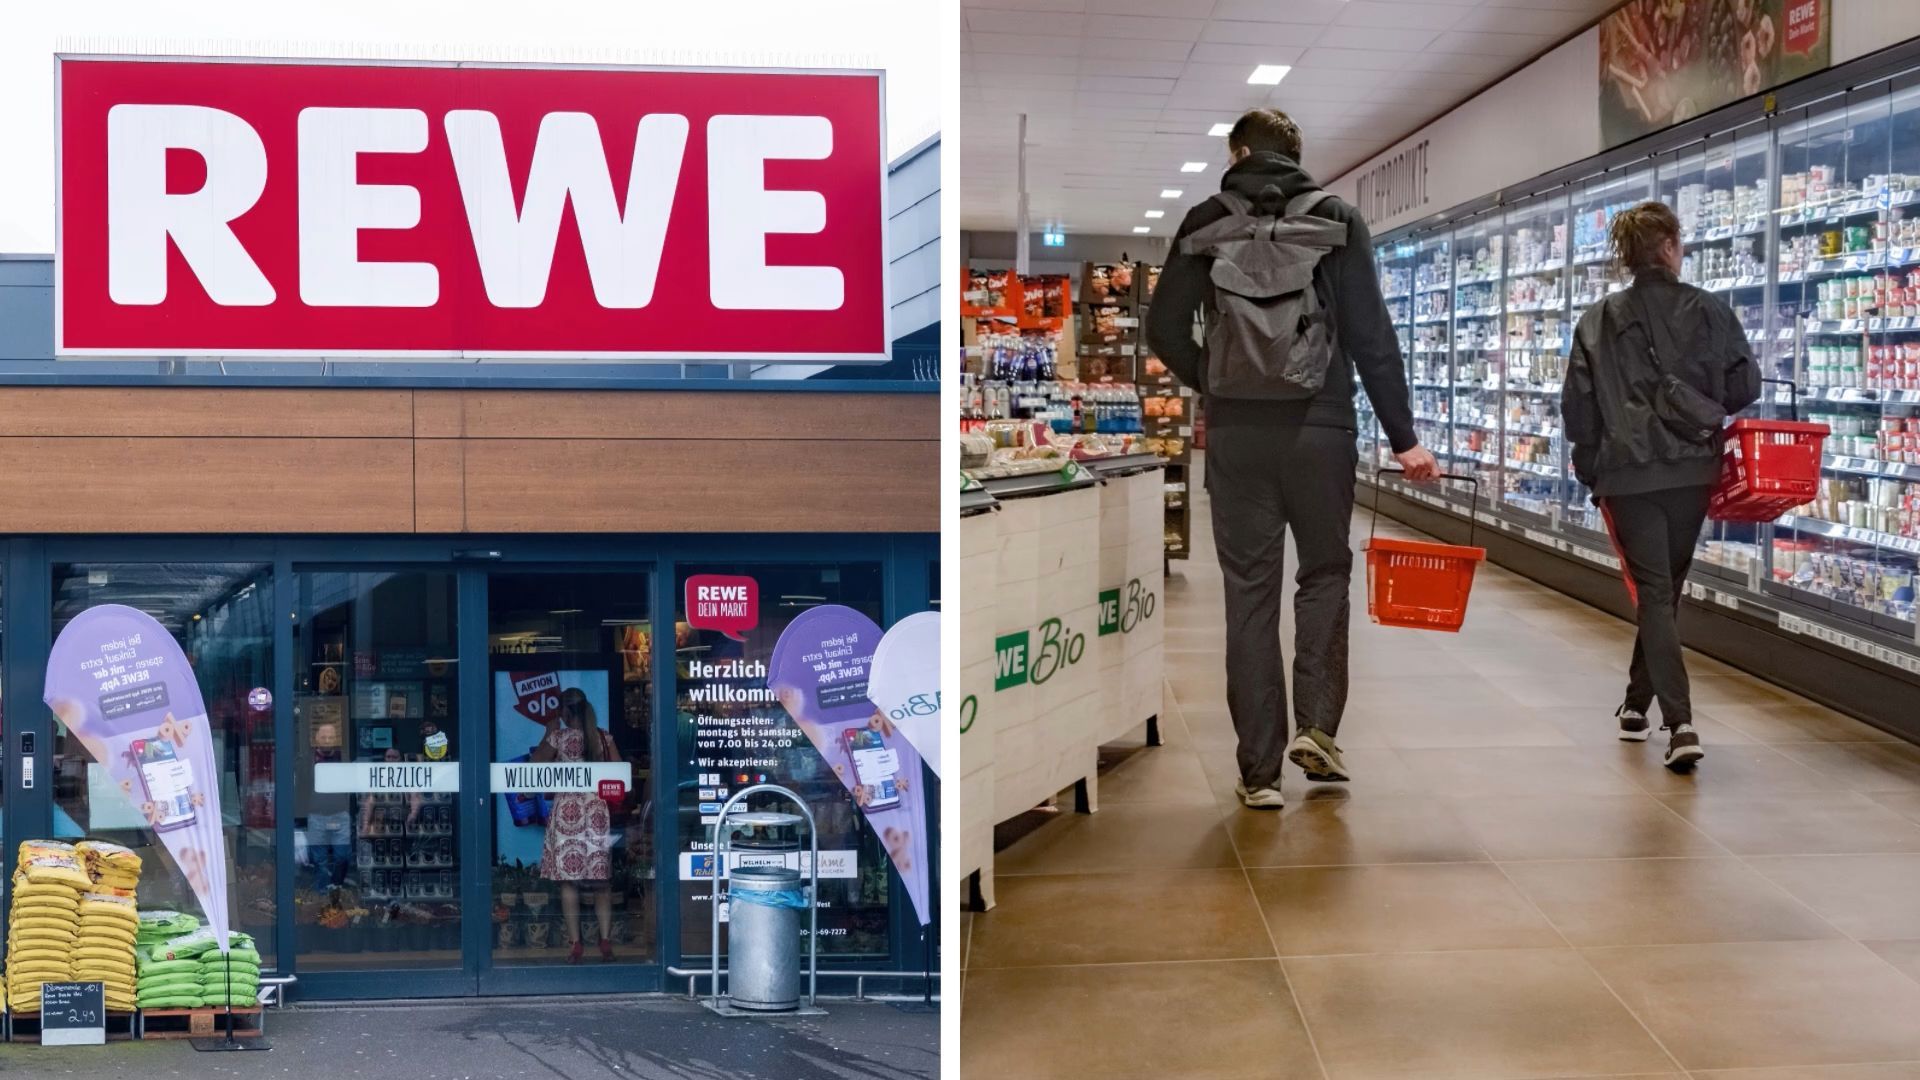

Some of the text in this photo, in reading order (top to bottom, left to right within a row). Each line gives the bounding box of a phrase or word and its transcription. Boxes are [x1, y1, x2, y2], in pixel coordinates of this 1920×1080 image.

[1789, 0, 1815, 26] REWE
[107, 103, 845, 311] REWE
[698, 586, 748, 600] REWE
[698, 602, 748, 616] DEIN MARKT
[1121, 578, 1155, 634] Bio
[1030, 617, 1085, 685] Bio
[689, 660, 766, 678] Herzlich
[520, 674, 553, 693] AKTION
[689, 684, 779, 702] willkomm
[698, 714, 774, 728] Öffnungszeiten:
[698, 728, 802, 738] montags bis samstags
[698, 739, 792, 748] von 7.00 bis 24.00
[698, 758, 778, 768] Wir akzeptieren:
[370, 766, 432, 788] HERZLICH
[504, 766, 592, 788] WILLKOMMEN
[690, 841, 724, 850] Unsee
